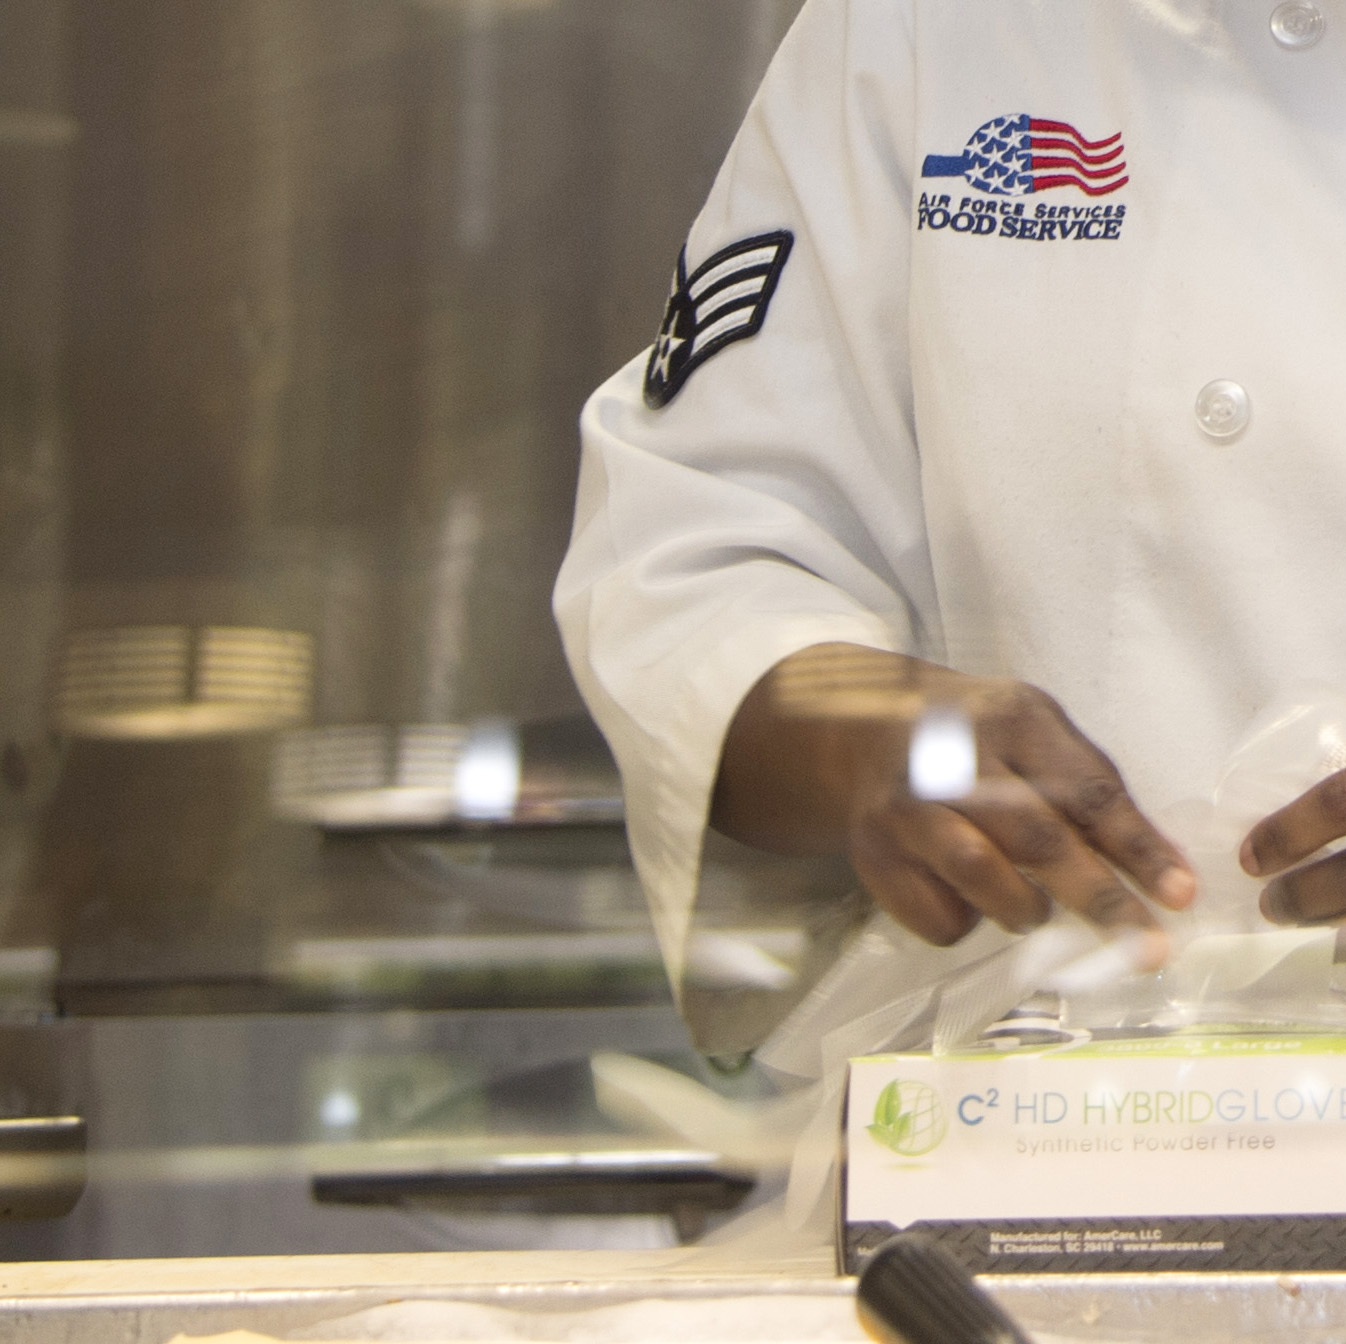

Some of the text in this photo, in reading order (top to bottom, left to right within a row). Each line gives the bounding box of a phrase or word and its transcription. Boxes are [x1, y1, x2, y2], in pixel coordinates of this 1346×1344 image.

[918, 192, 1127, 219] AIR FORCE SERVICES
[917, 207, 1123, 241] FOOD SERVICE
[1014, 1092, 1068, 1125] HD
[1016, 1131, 1276, 1157] Synthetic Powder Free
[990, 1231, 1061, 1243] Manufactured
[1140, 1229, 1162, 1240] LLC
